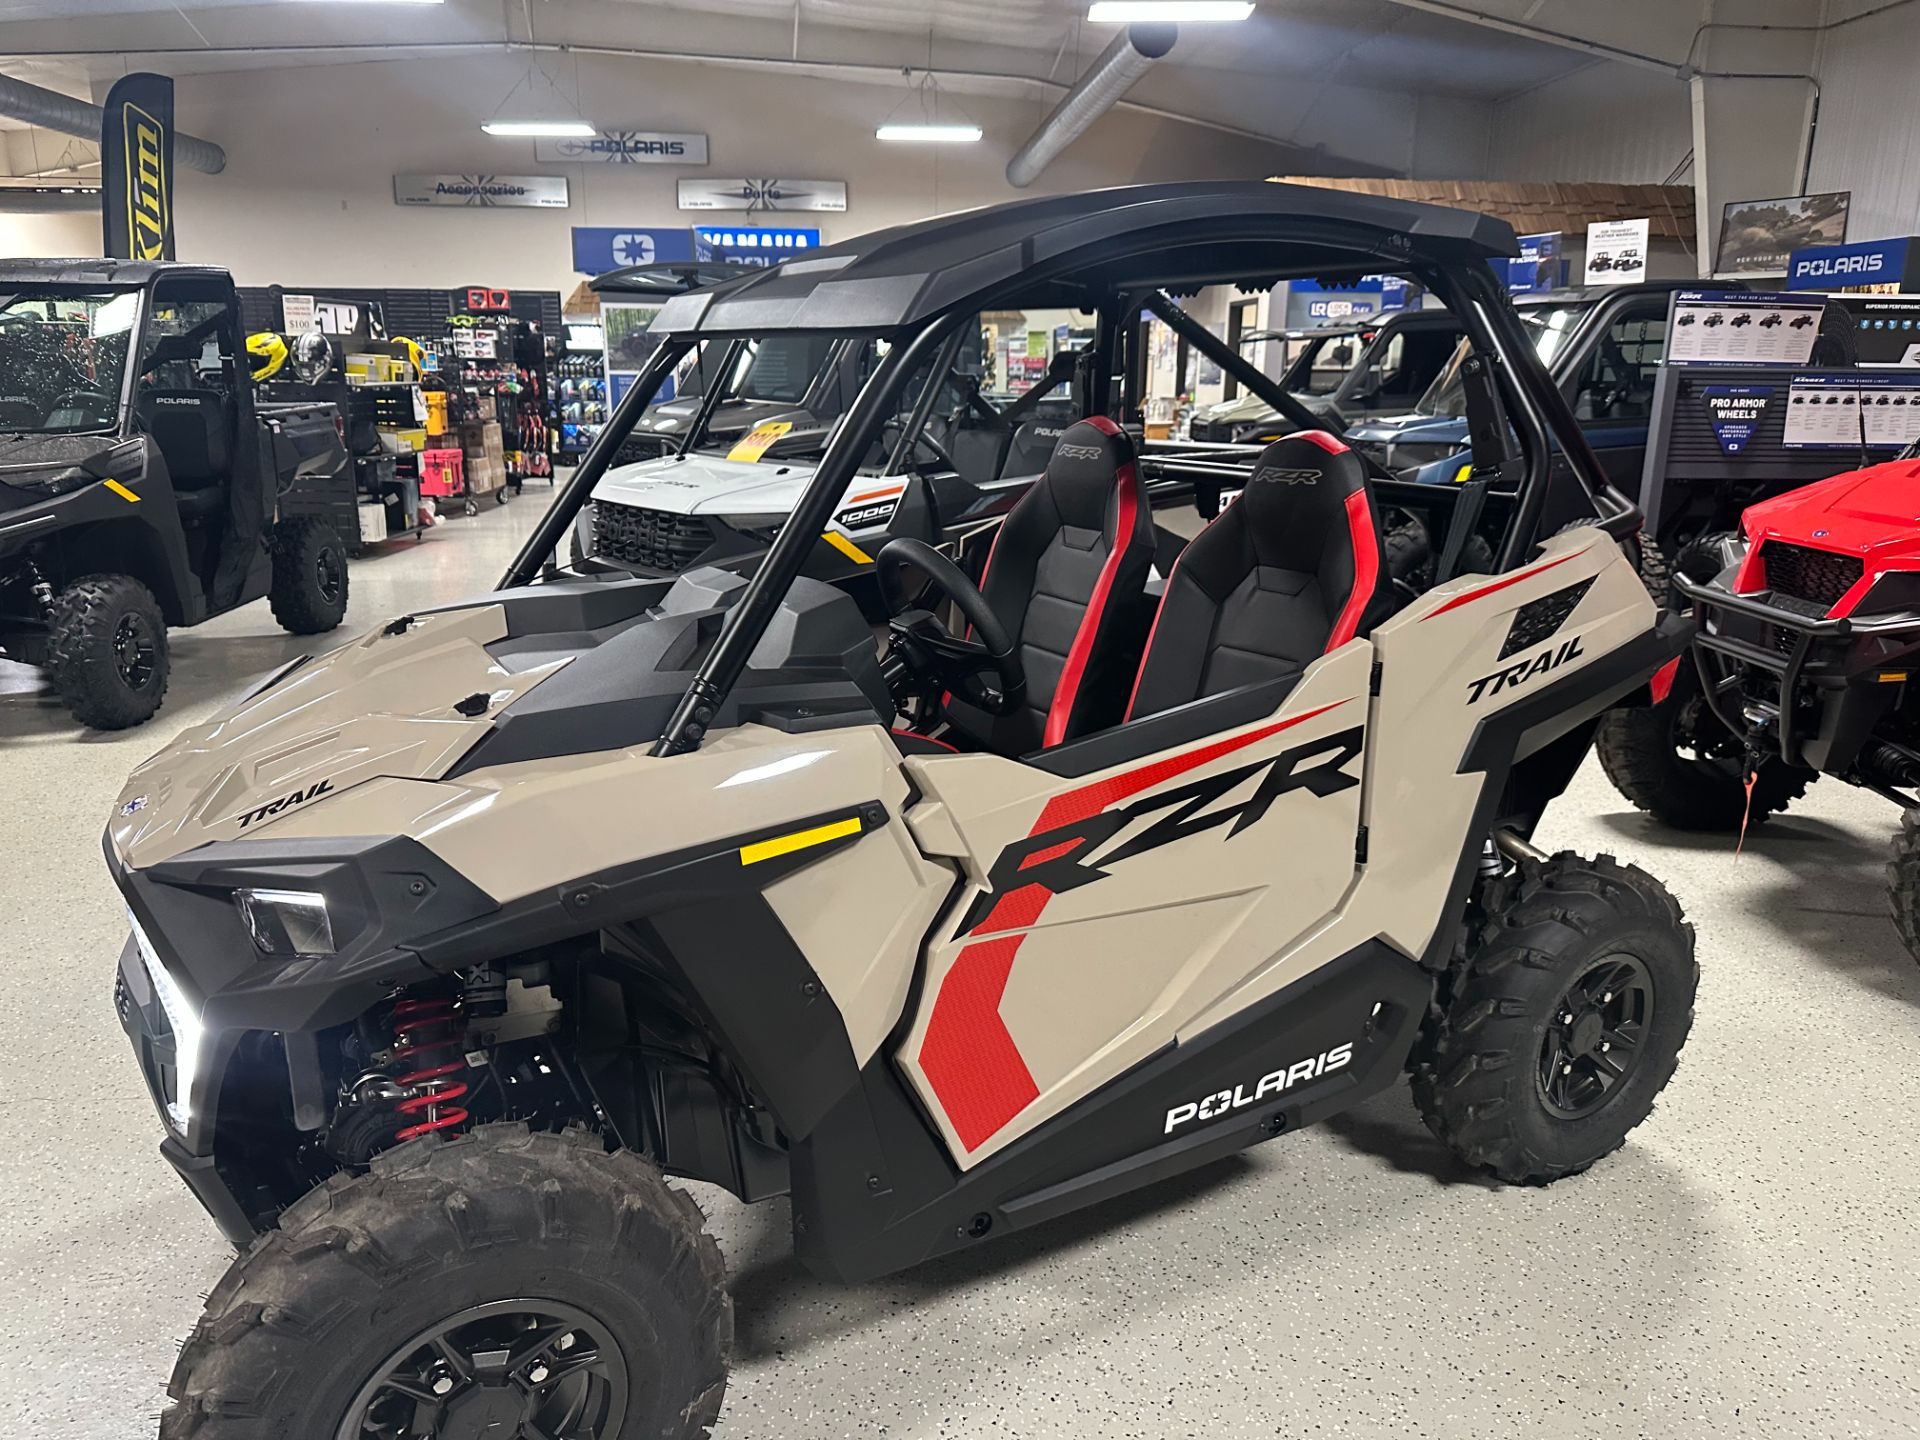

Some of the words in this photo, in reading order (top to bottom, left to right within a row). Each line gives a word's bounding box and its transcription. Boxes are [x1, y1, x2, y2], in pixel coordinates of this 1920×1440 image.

[590, 140, 685, 155] POLARIS
[436, 182, 525, 196] Accessories
[743, 187, 781, 200] Parts
[703, 233, 808, 247] YAMAHA
[1796, 253, 1884, 277] POLARIS
[289, 319, 310, 329] $100
[156, 397, 200, 405] POLARIS
[1710, 398, 1731, 408] PRO
[1731, 398, 1766, 408] ARMOR
[1717, 409, 1757, 419] WHEELS
[1057, 443, 1102, 460] RZR
[1255, 466, 1322, 485] RZR
[841, 503, 895, 523] 1000
[1466, 635, 1584, 705] TRAIL
[237, 779, 335, 828] TRAIL
[951, 724, 1365, 942] RZR
[1164, 1042, 1353, 1134] POLARIS
